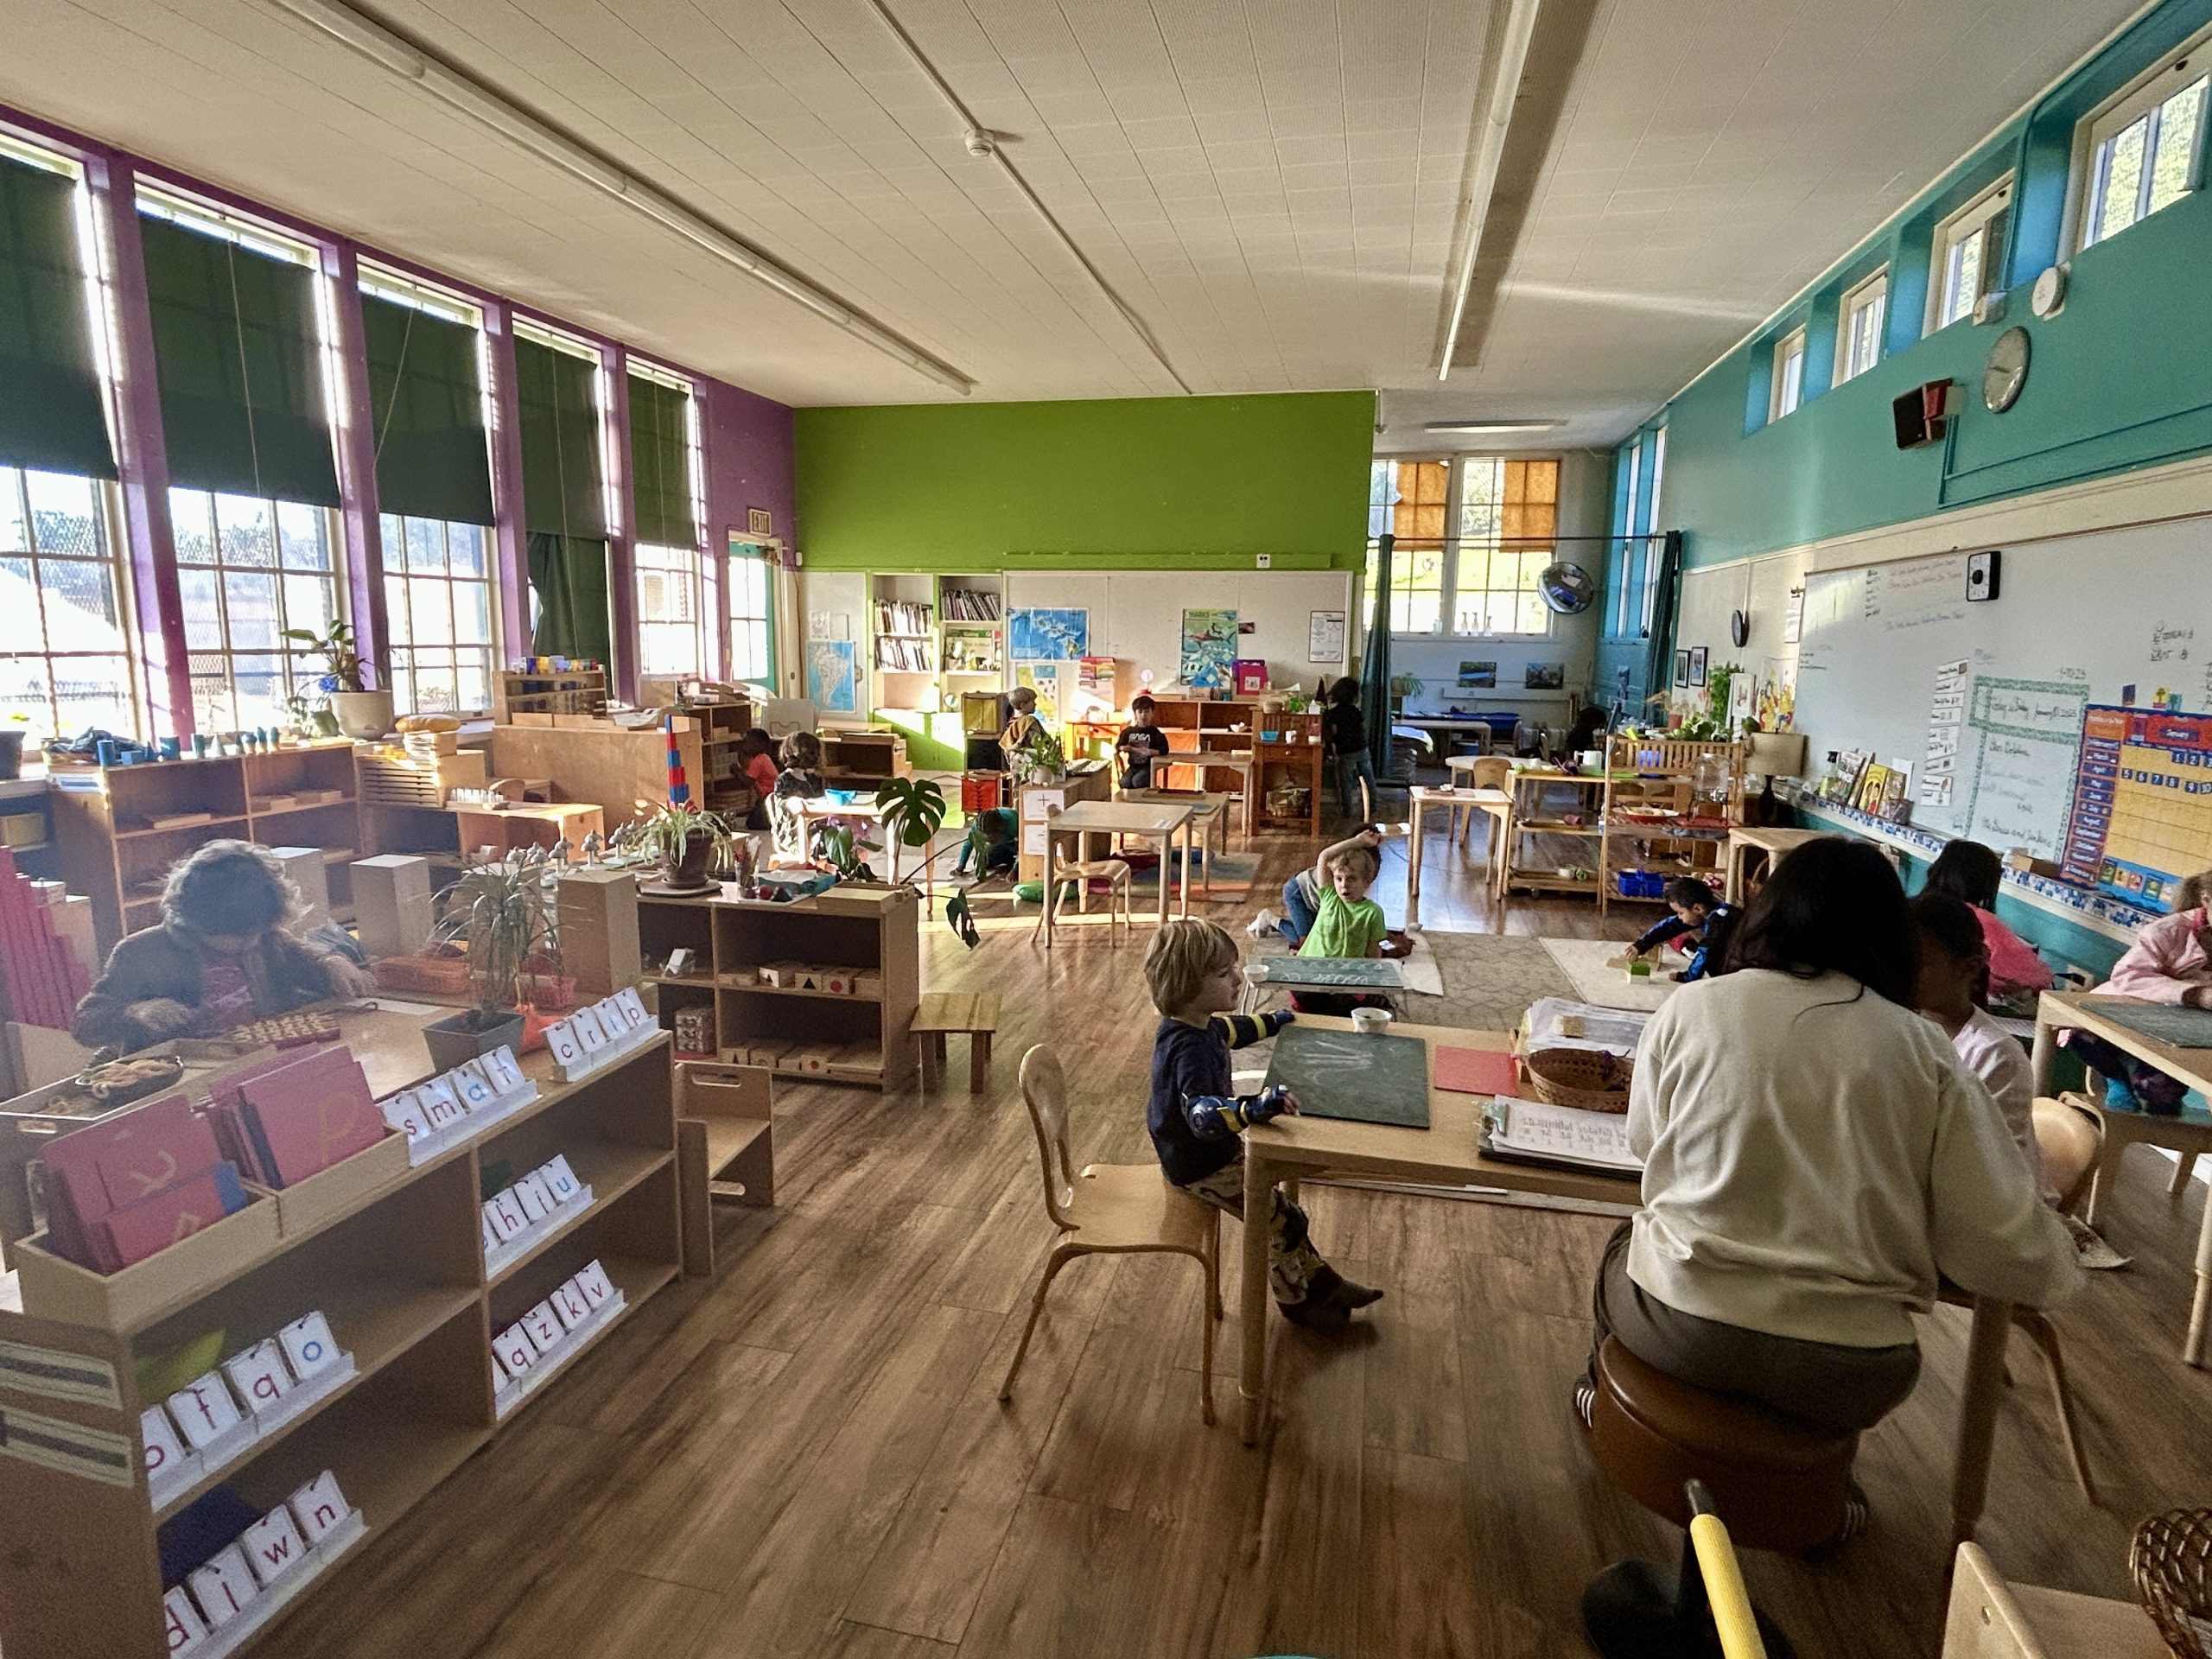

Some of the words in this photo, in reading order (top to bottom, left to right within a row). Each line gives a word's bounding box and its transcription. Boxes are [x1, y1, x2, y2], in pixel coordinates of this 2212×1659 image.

[1128, 733, 1151, 742] NASA
[2190, 755, 2197, 766] 2
[2154, 774, 2161, 784] 7
